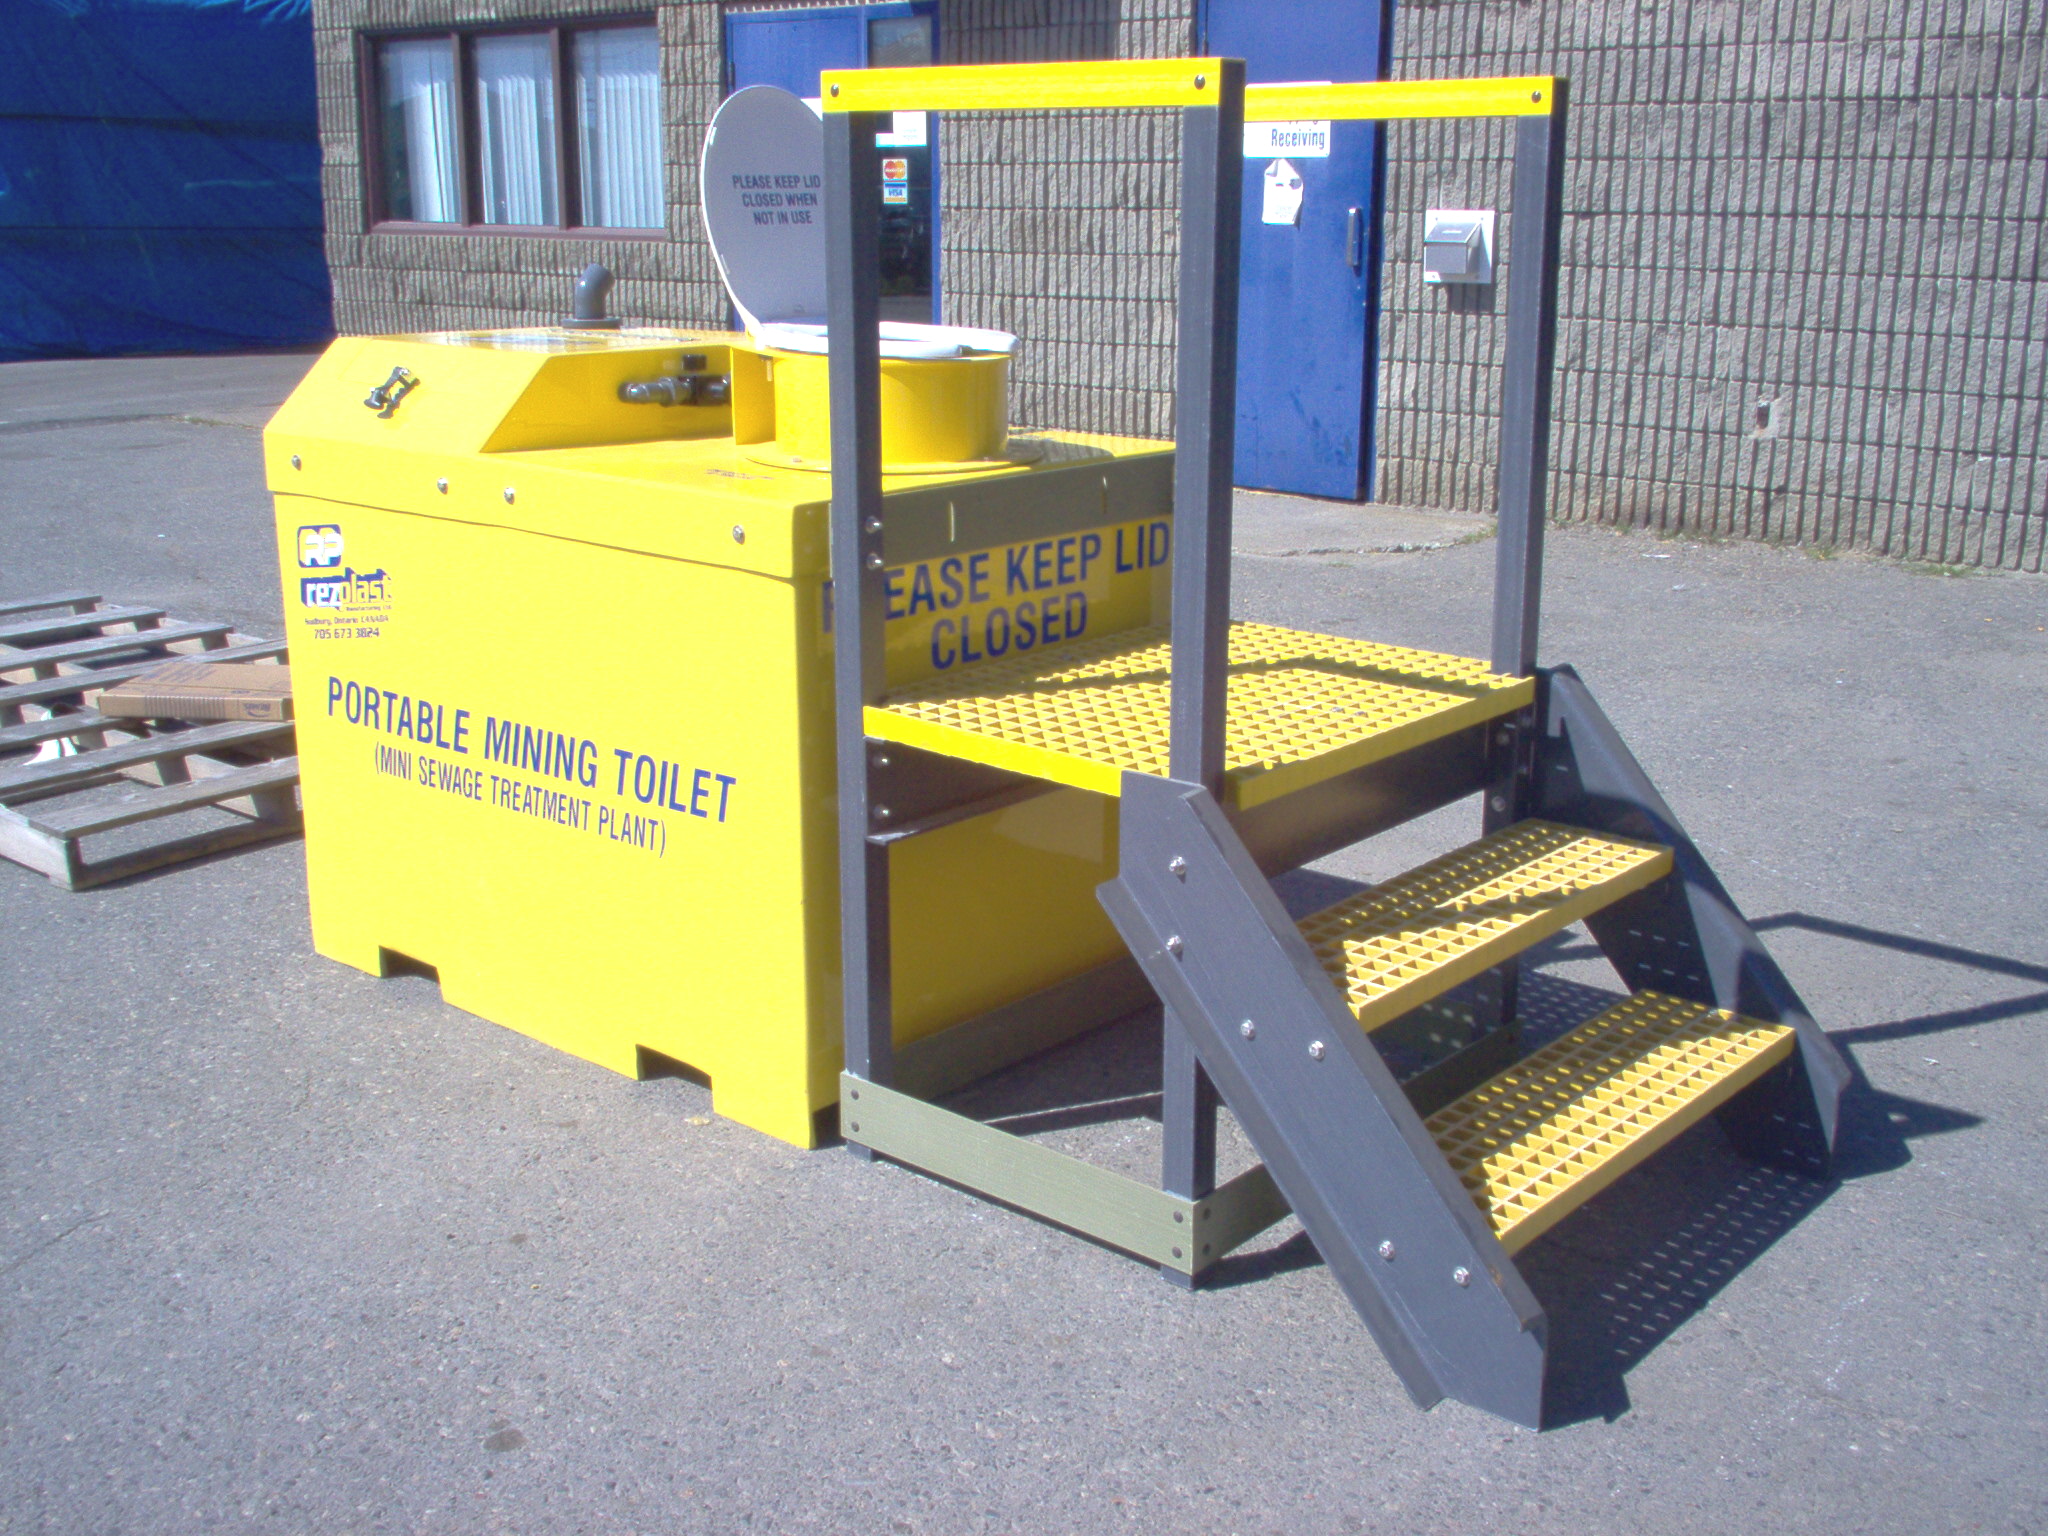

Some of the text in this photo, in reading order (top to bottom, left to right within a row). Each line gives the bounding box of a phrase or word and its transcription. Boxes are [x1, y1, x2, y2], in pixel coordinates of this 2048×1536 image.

[1271, 128, 1325, 150] Receiving
[732, 174, 821, 189] PLEASE KEEP LID
[741, 192, 818, 207] CLOSED WHEN
[753, 210, 813, 225] NOT IN USE
[822, 522, 1170, 634] PEASE KEEP LID
[314, 628, 331, 639] 705
[334, 628, 352, 639] 673
[930, 591, 1088, 670] CLOSED
[328, 676, 737, 823] PORTABLE MINING TOILET
[374, 741, 666, 858] (MINI SEWAGE TREATMENT PLANT)
